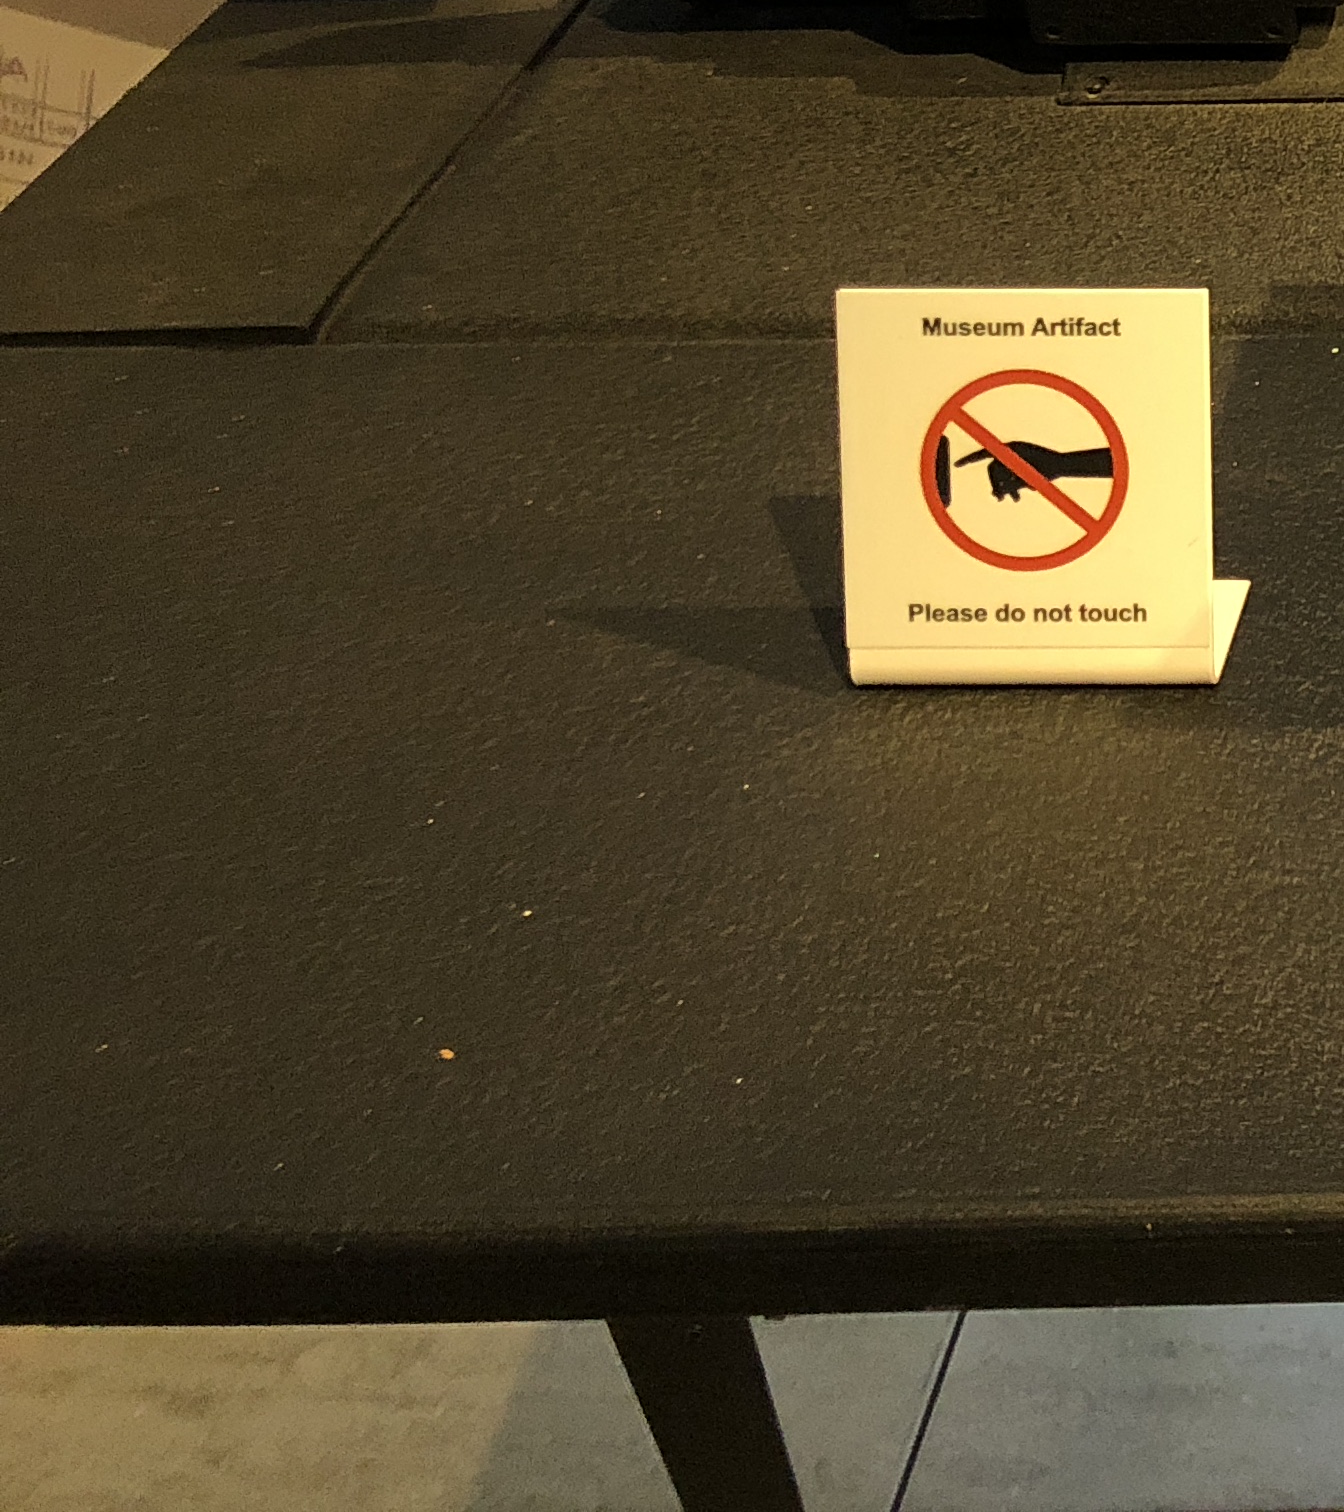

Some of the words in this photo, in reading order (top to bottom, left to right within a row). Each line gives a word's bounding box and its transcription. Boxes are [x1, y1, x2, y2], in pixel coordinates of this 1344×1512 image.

[921, 317, 1025, 337] Museum
[1031, 317, 1122, 337] Artifact
[908, 603, 988, 623] Please
[995, 603, 1026, 623] do
[1033, 605, 1073, 623] not
[1079, 603, 1148, 623] touch
